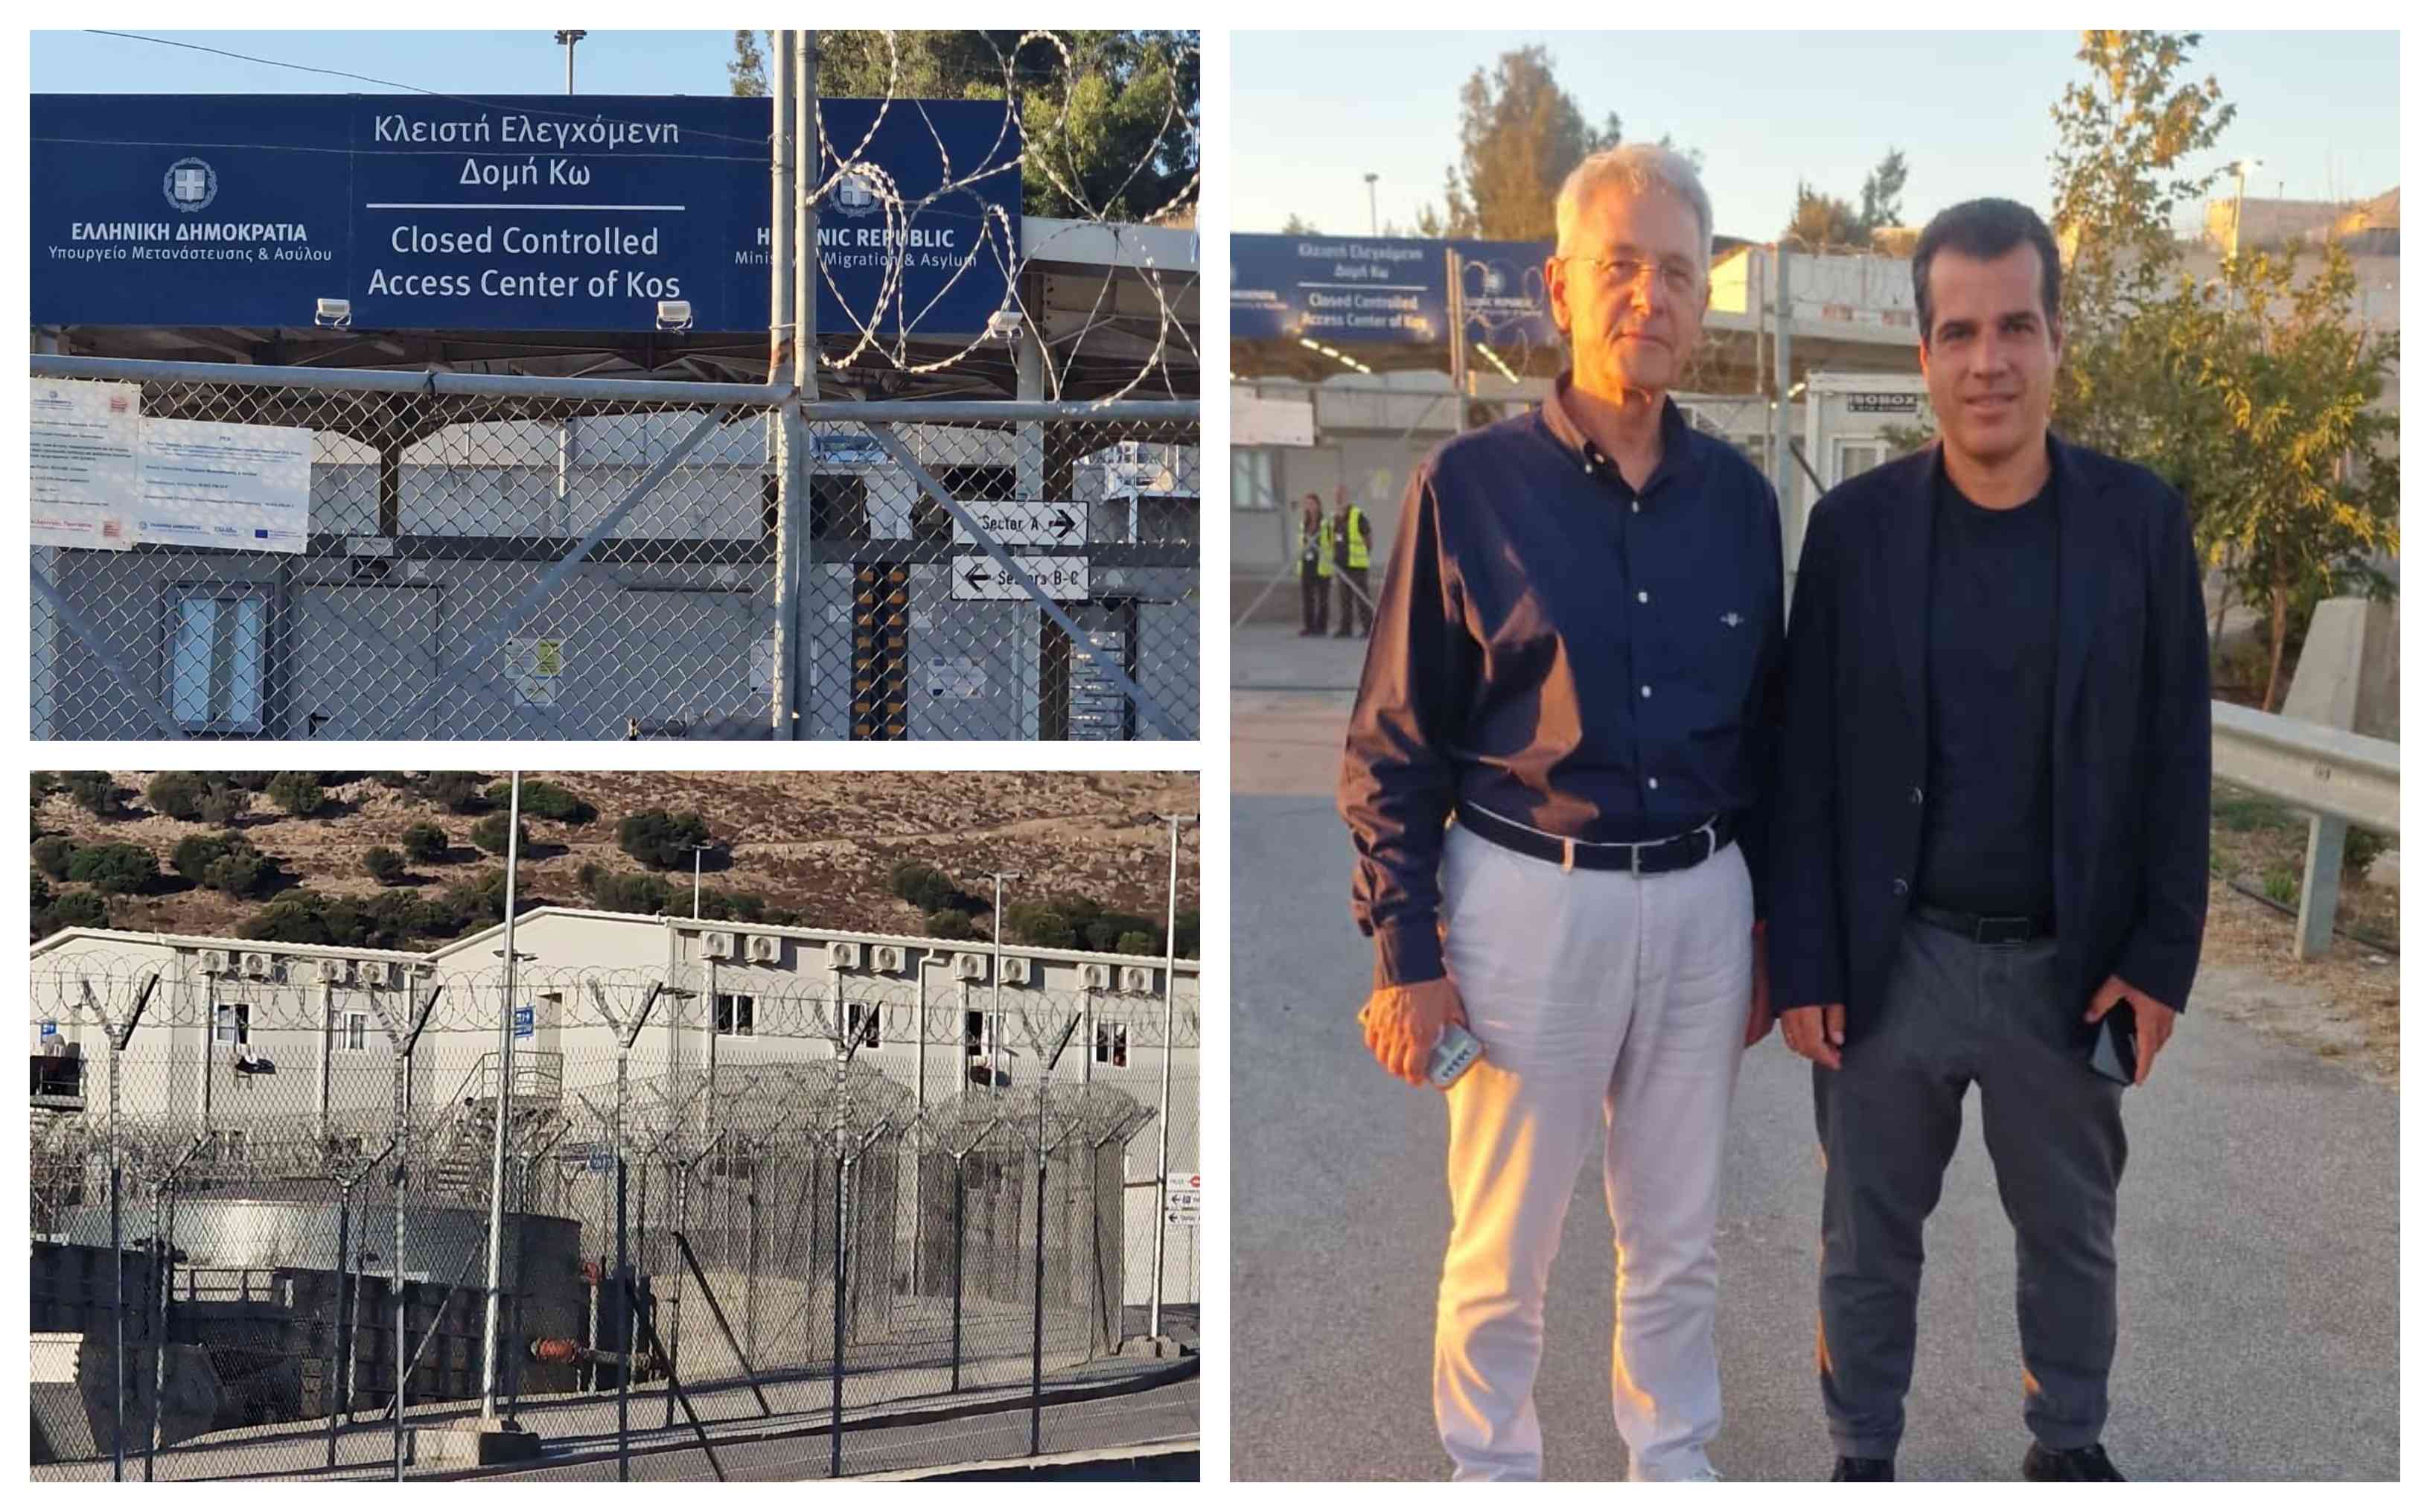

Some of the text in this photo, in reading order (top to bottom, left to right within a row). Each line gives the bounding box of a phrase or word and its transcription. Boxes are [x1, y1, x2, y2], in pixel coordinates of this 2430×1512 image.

[374, 113, 679, 149] Κλειστή Ελεγχόμενη
[460, 156, 590, 191] Δομή Κω
[72, 223, 307, 242] ΕΛΛΗΝΙΚΗ ΔΗΜΟΚΡΑΤΙΑ
[392, 226, 659, 255] Closed Controlled
[757, 227, 954, 248] HNIC REPUBLIC
[49, 245, 332, 263] Υπουργείο Μετανάστευσης & Ασύλου
[824, 251, 899, 268] Migration
[905, 252, 915, 266] &
[920, 252, 977, 269] Asylum
[368, 269, 680, 298] Access Center of Kos
[982, 514, 1039, 531] Sector A
[998, 570, 1079, 585] Sers B-C
